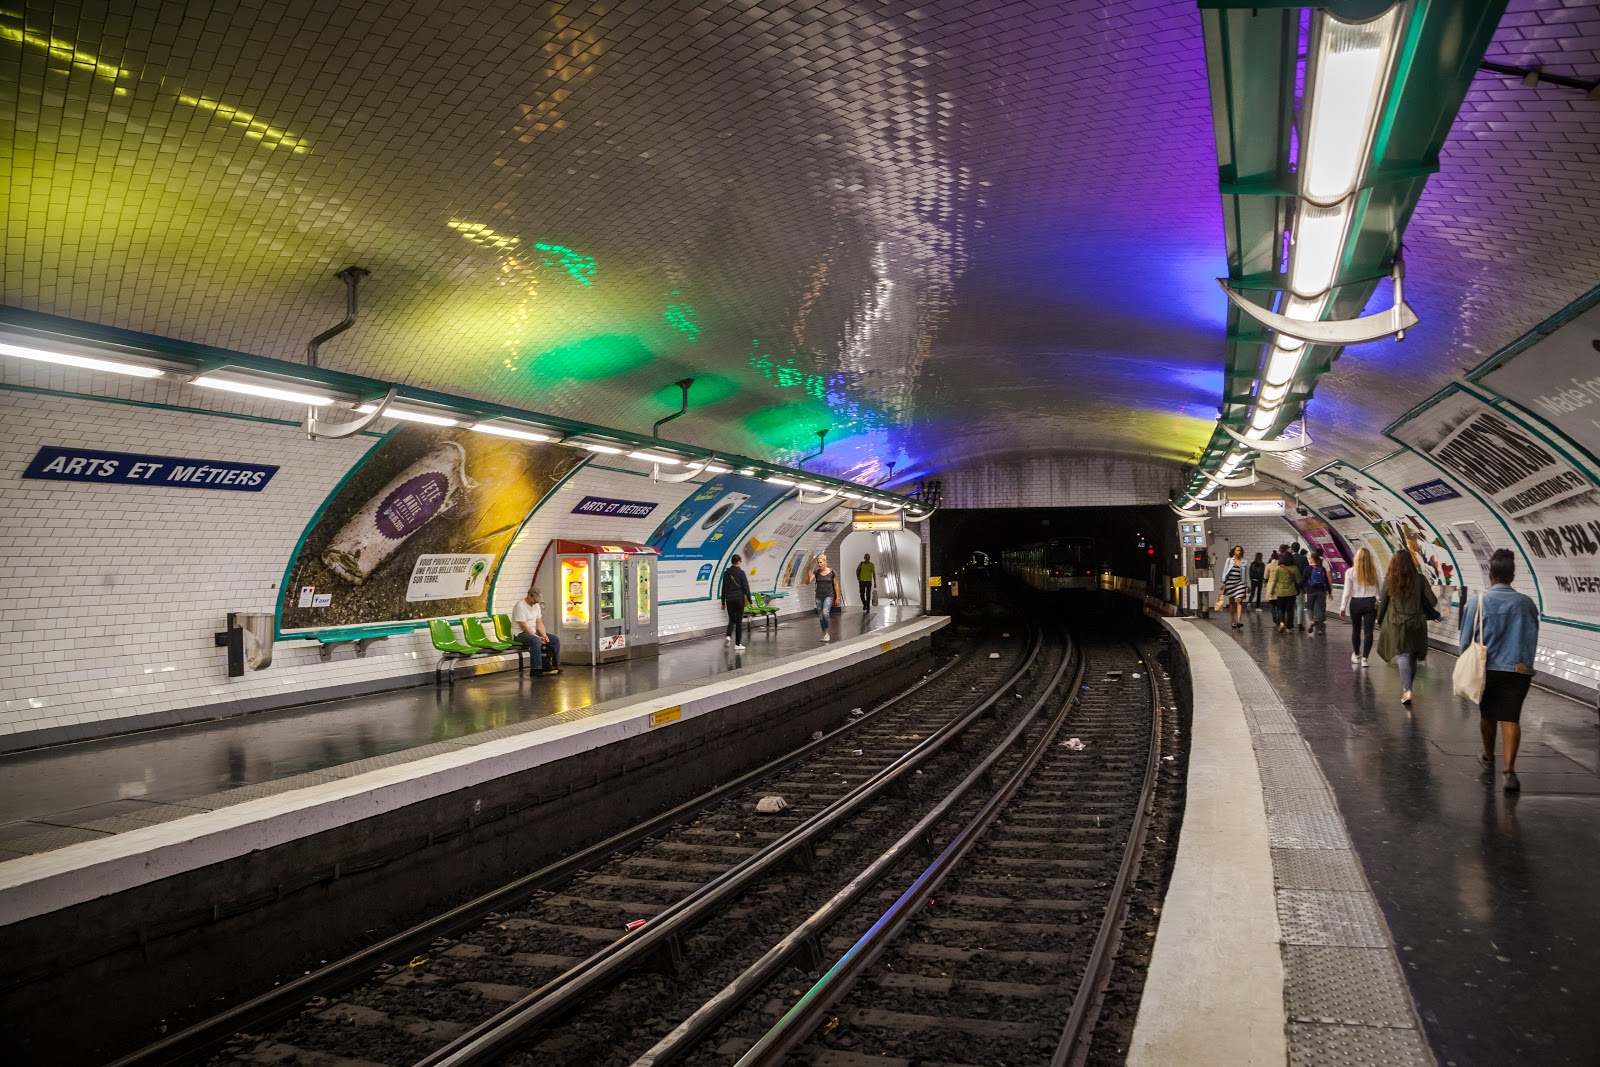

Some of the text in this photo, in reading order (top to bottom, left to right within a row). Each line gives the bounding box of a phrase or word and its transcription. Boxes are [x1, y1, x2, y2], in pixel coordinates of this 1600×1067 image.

[1533, 386, 1593, 417] Made
[1436, 412, 1557, 496] GENERATIONS
[42, 455, 266, 487] ARTS ET MÉTIERS
[402, 494, 422, 517] MARIE
[580, 501, 653, 516] ARTS ET MÉTIERS
[1536, 526, 1567, 558] HOP
[1558, 522, 1598, 556] SOUL
